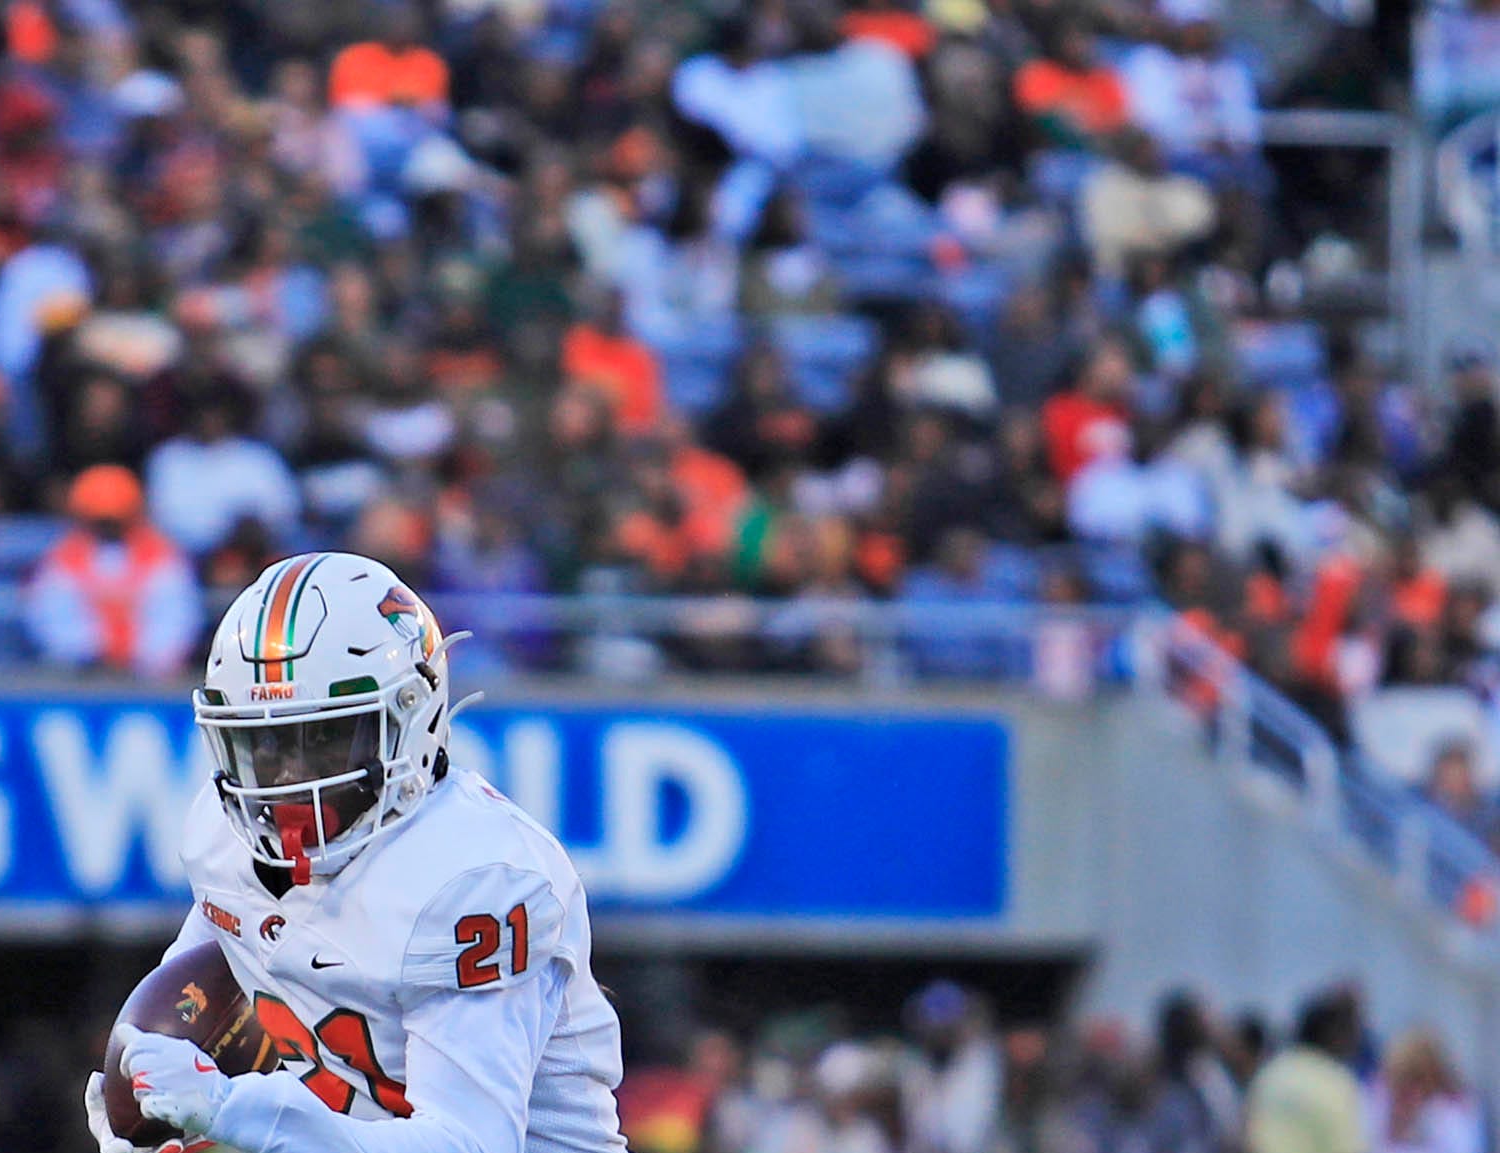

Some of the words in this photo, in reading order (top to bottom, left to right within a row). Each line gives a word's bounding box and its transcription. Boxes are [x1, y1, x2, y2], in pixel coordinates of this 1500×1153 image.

[250, 683, 293, 701] FAMU
[34, 708, 750, 898] WLD
[456, 902, 529, 989] 21
[253, 990, 415, 1120] 21
